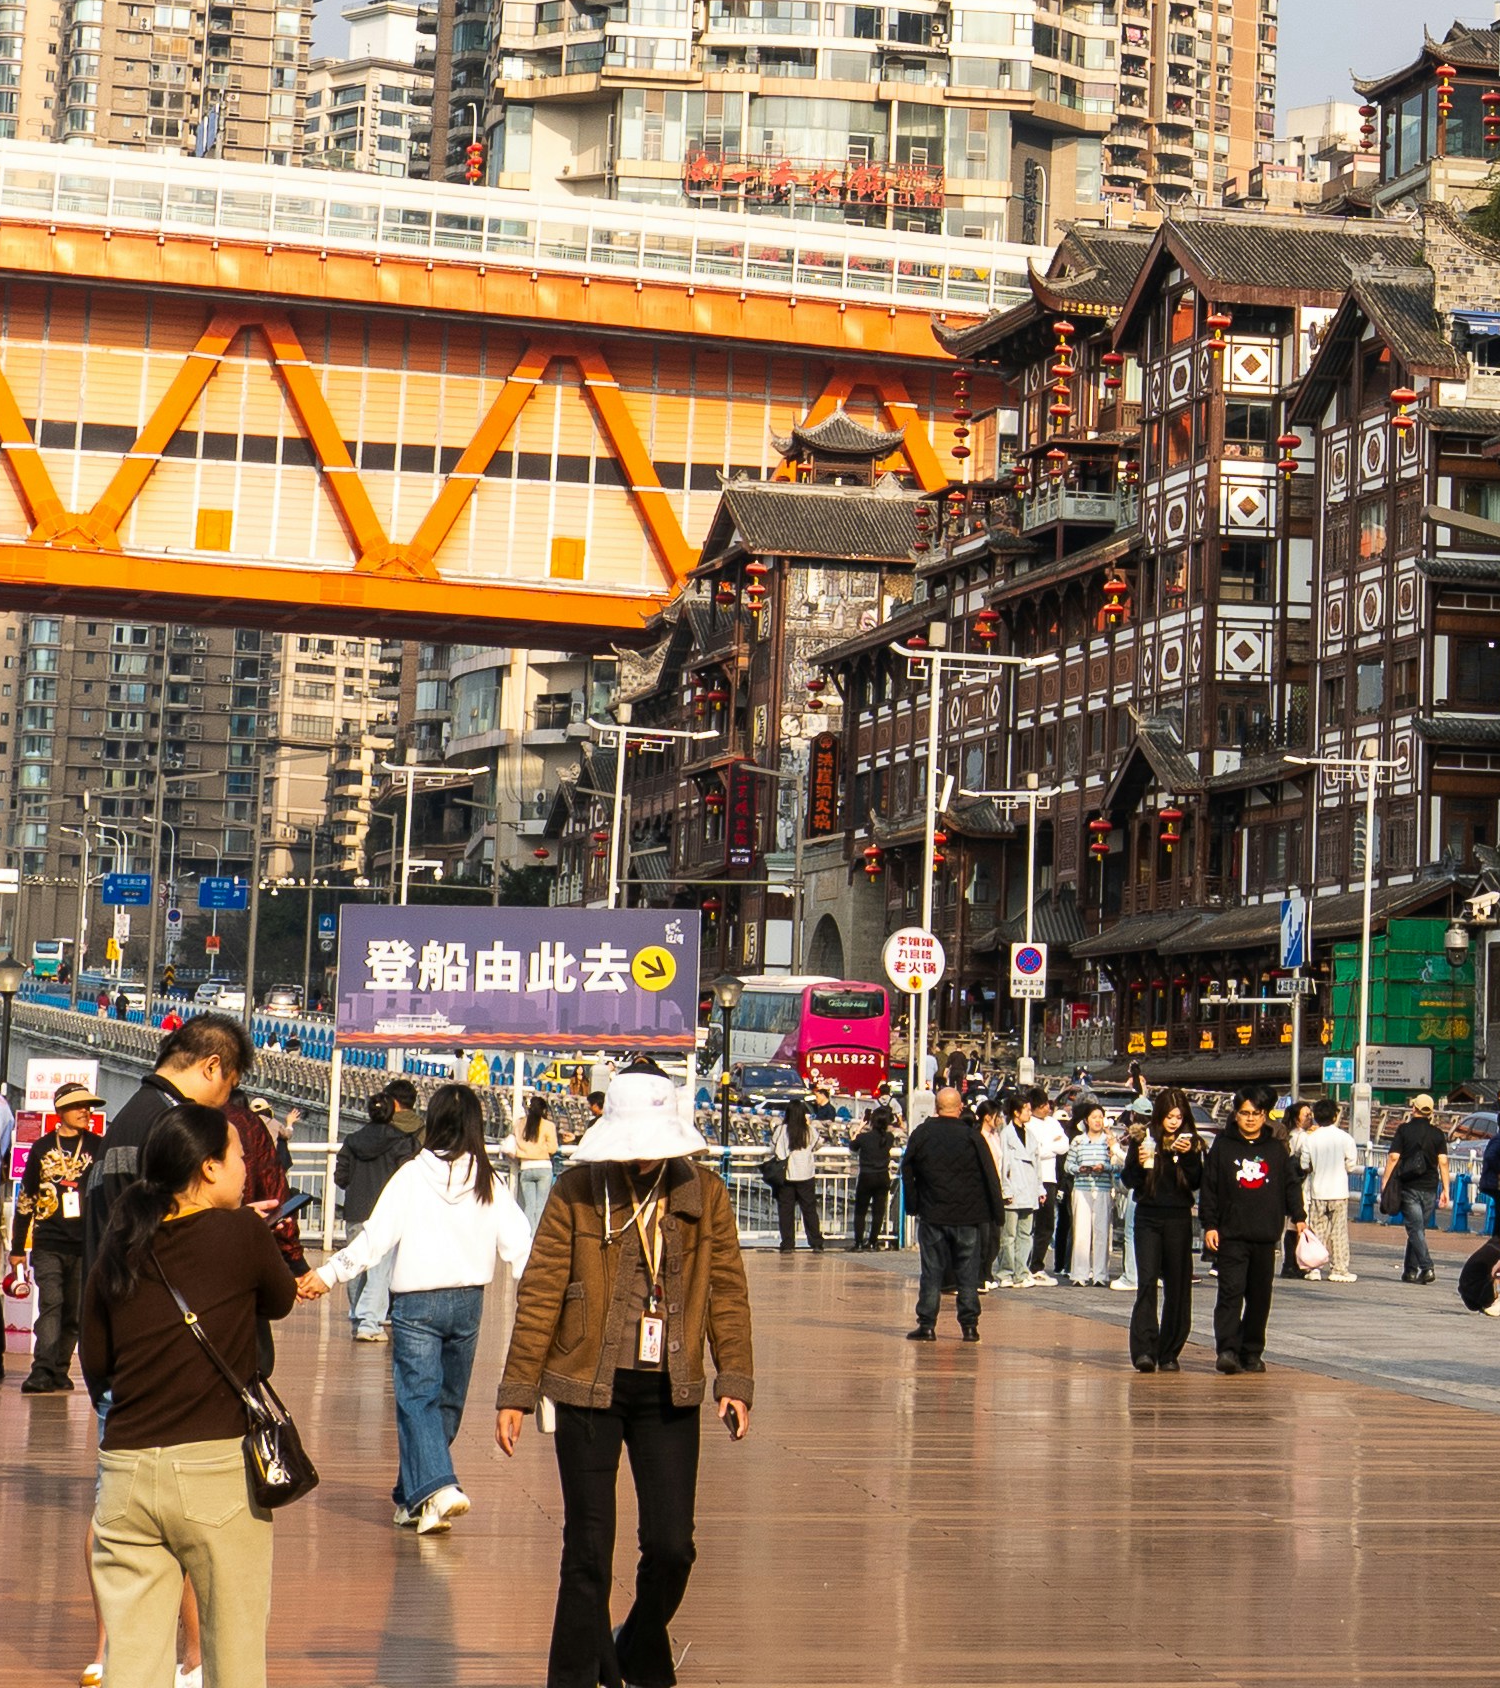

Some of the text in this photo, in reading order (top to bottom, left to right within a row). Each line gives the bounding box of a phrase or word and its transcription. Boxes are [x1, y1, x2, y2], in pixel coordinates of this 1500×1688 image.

[364, 939, 631, 994] 登船由此去
[894, 962, 937, 974] 老火锅
[50, 1073, 90, 1084] 渝中区
